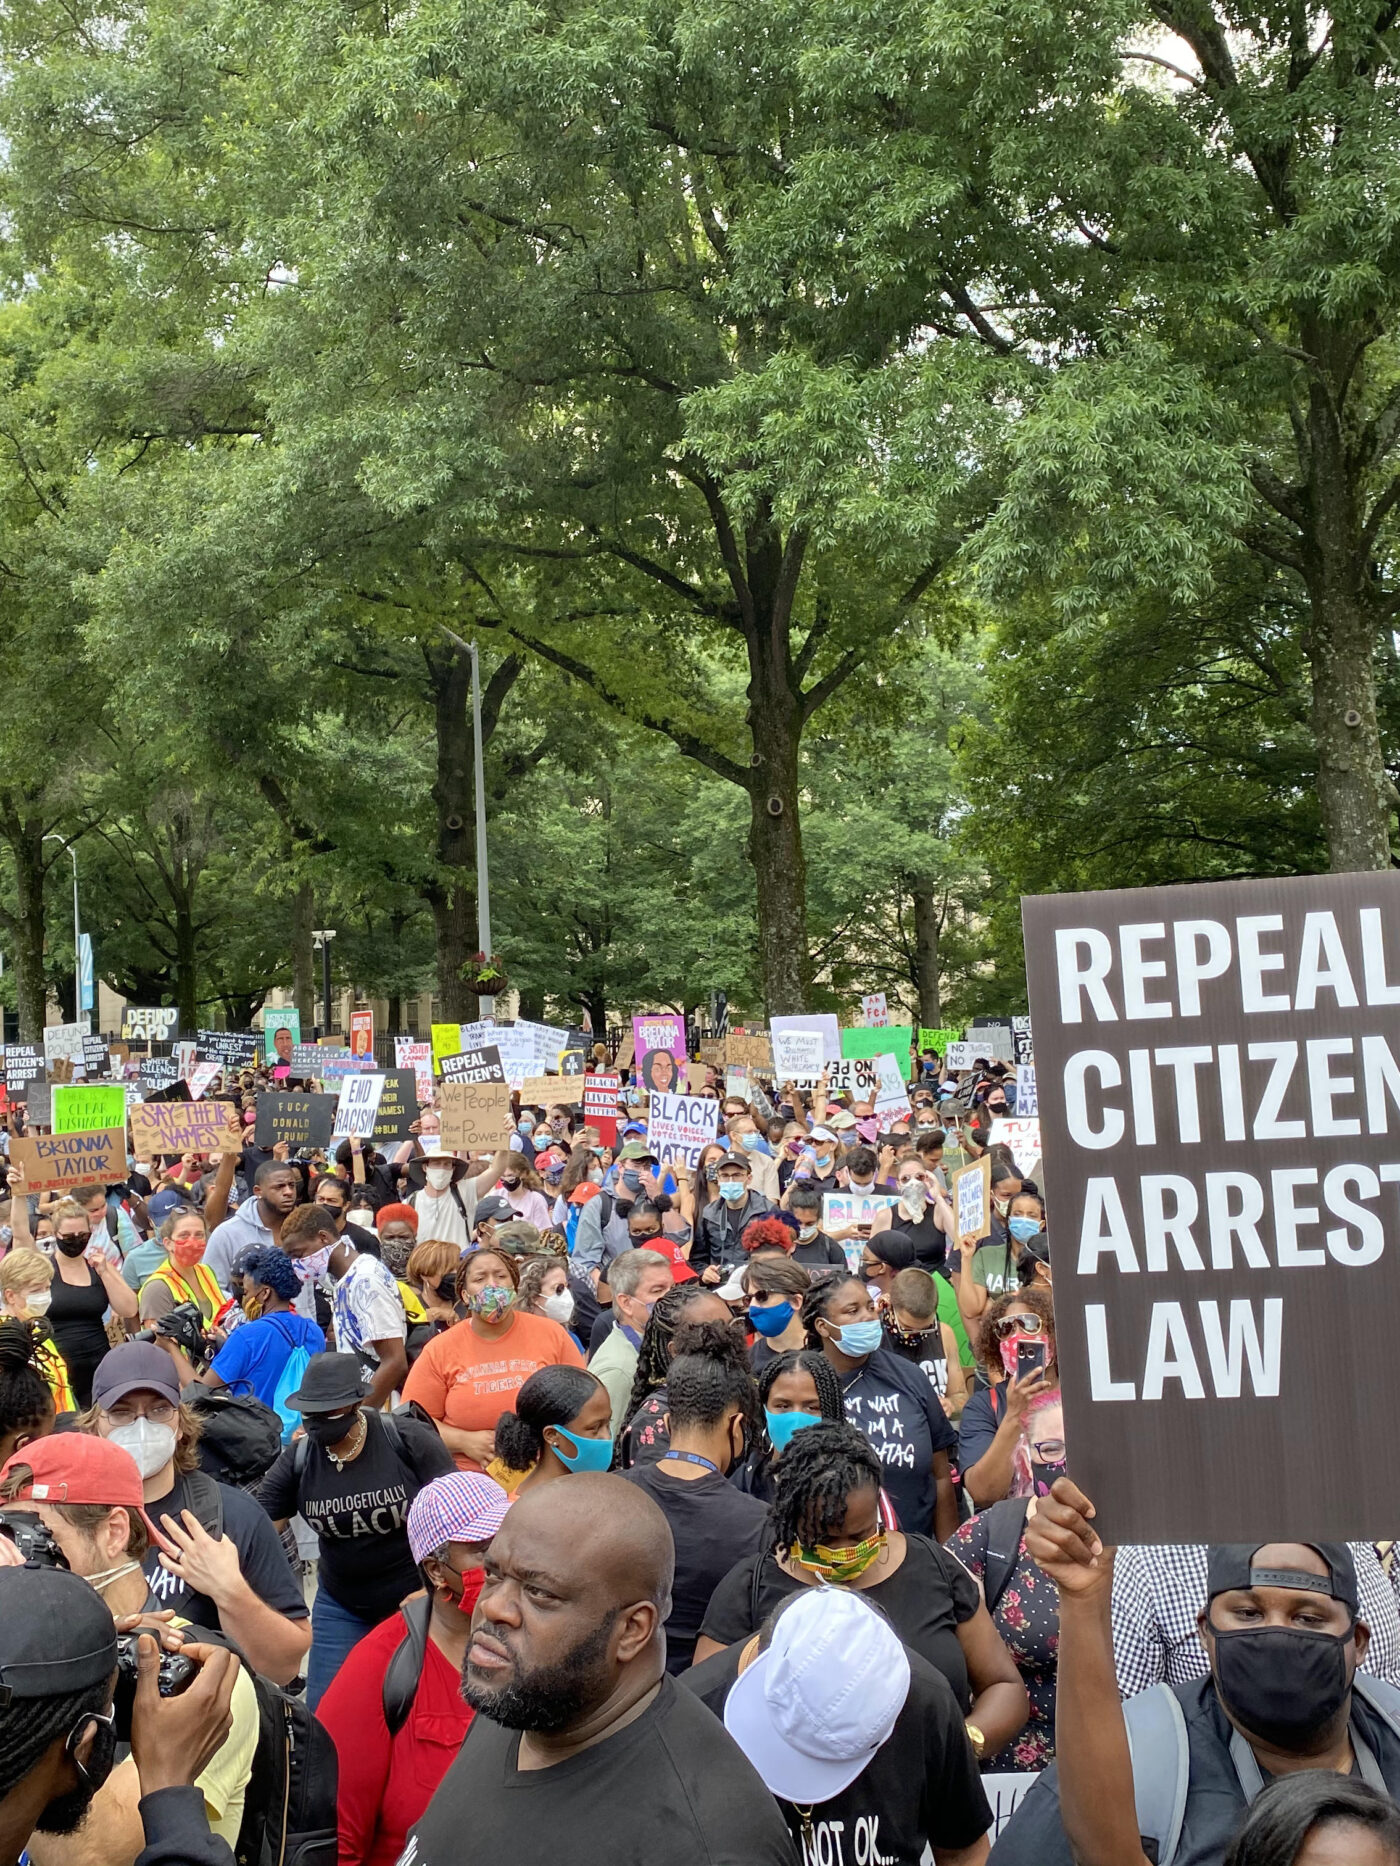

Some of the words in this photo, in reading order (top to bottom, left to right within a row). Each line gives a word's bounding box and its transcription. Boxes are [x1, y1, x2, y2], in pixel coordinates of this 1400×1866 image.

[1055, 907, 1400, 1024] REPEAL
[127, 1008, 177, 1025] DEFUND
[47, 1026, 88, 1041] DEFUND
[131, 1024, 169, 1040] APD
[639, 1025, 680, 1038] BREONNA
[922, 1030, 956, 1039] DEFEND
[83, 1036, 102, 1045] REPEAL
[216, 1042, 243, 1052] UNREST
[645, 1037, 675, 1049] TAYLOR
[6, 1046, 36, 1057] REPEAL
[47, 1042, 82, 1055] POLIC
[951, 1045, 965, 1053] NO
[6, 1056, 45, 1068] CITIZEN'S
[86, 1062, 97, 1071] LAW
[441, 1052, 487, 1074] REPEAL
[950, 1057, 964, 1066] NO
[7, 1068, 37, 1080] ARREST
[140, 1063, 177, 1076] SILENCE
[7, 1080, 25, 1090] LAW
[586, 1077, 616, 1087] BLACK
[348, 1079, 373, 1103] END
[586, 1092, 616, 1104] LIVES
[464, 1085, 506, 1112] People
[278, 1102, 310, 1112] FUCK
[586, 1106, 616, 1116] MATTER
[651, 1094, 717, 1127] BLACK
[141, 1104, 175, 1127] SAY
[181, 1103, 229, 1126] THEIR
[335, 1108, 376, 1134] RACISM
[272, 1118, 310, 1128] DONALD
[652, 1121, 674, 1131] LIVES
[159, 1126, 220, 1149] NAMES
[276, 1131, 310, 1142] TRUMP
[462, 1119, 507, 1144] Power
[651, 1130, 677, 1140] VOTES
[36, 1134, 113, 1158] BRIONNA
[649, 1140, 701, 1168] MATTE
[48, 1155, 112, 1177] TAYLOR
[28, 1181, 42, 1191] NO
[44, 1178, 78, 1188] JUSTICE
[1085, 1298, 1283, 1402] LAW
[473, 1375, 524, 1395] TIGERS
[867, 1393, 900, 1415] WAIT
[892, 1418, 904, 1438] A
[305, 1484, 407, 1517] UNAPOLOGETICALLY
[307, 1499, 408, 1538] BLACK
[801, 1820, 845, 1866] NOT
